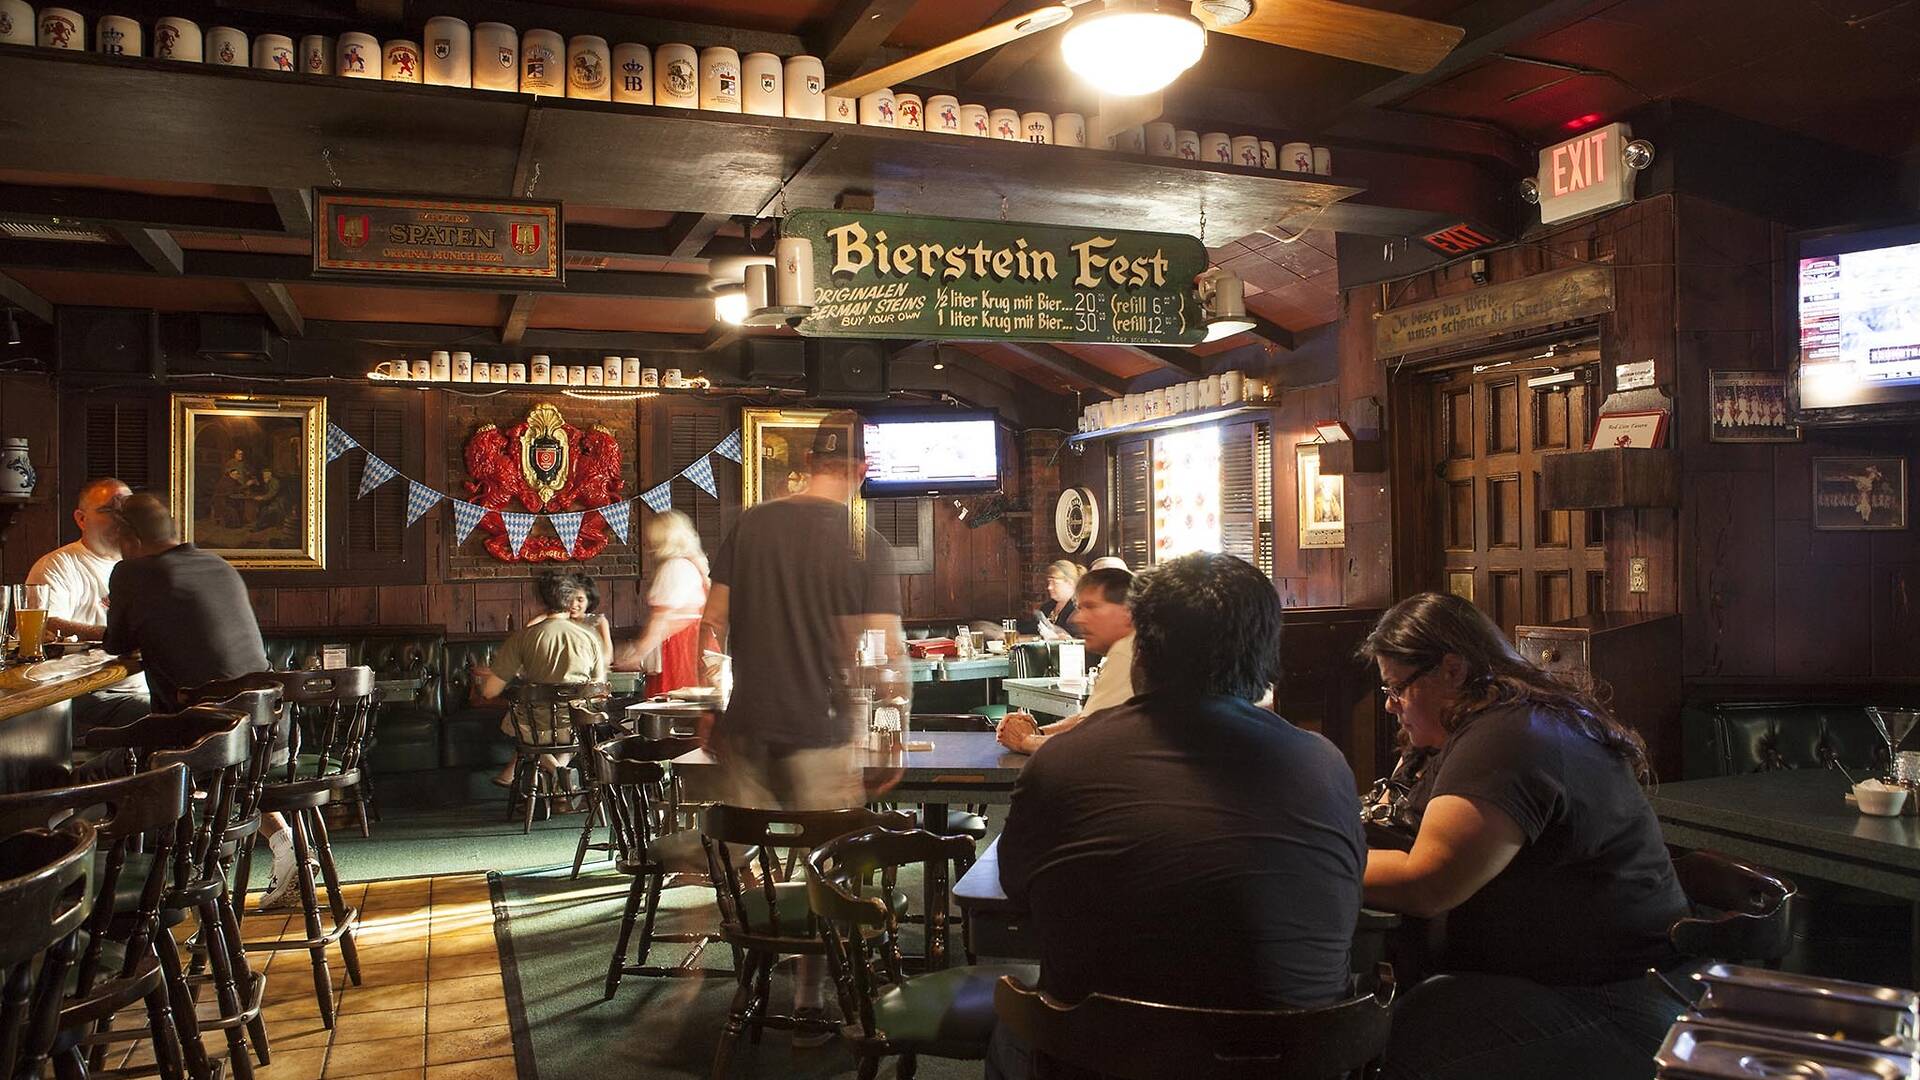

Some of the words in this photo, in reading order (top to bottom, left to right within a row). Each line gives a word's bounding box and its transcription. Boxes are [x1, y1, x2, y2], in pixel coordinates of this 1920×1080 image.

[625, 76, 643, 92] HB
[1553, 132, 1608, 197] EXIT
[390, 224, 496, 248] SPATEN
[1424, 224, 1494, 254] EXIT
[383, 248, 431, 259] ORIGINAL
[433, 250, 475, 261] MUNICH
[827, 221, 1058, 282] Bierstein
[1071, 236, 1169, 288] Fest
[875, 296, 927, 314] STEINS
[950, 292, 978, 309] liter
[982, 290, 1009, 313] Krug
[1013, 294, 1033, 310] mit
[841, 316, 864, 326] BUY
[868, 314, 895, 325] YOUR
[898, 311, 922, 321] OWN
[937, 309, 944, 326] 1
[950, 311, 978, 326] liter
[982, 310, 1011, 333] Krug
[1013, 313, 1034, 330] mit
[538, 550, 569, 559] ANGELE
